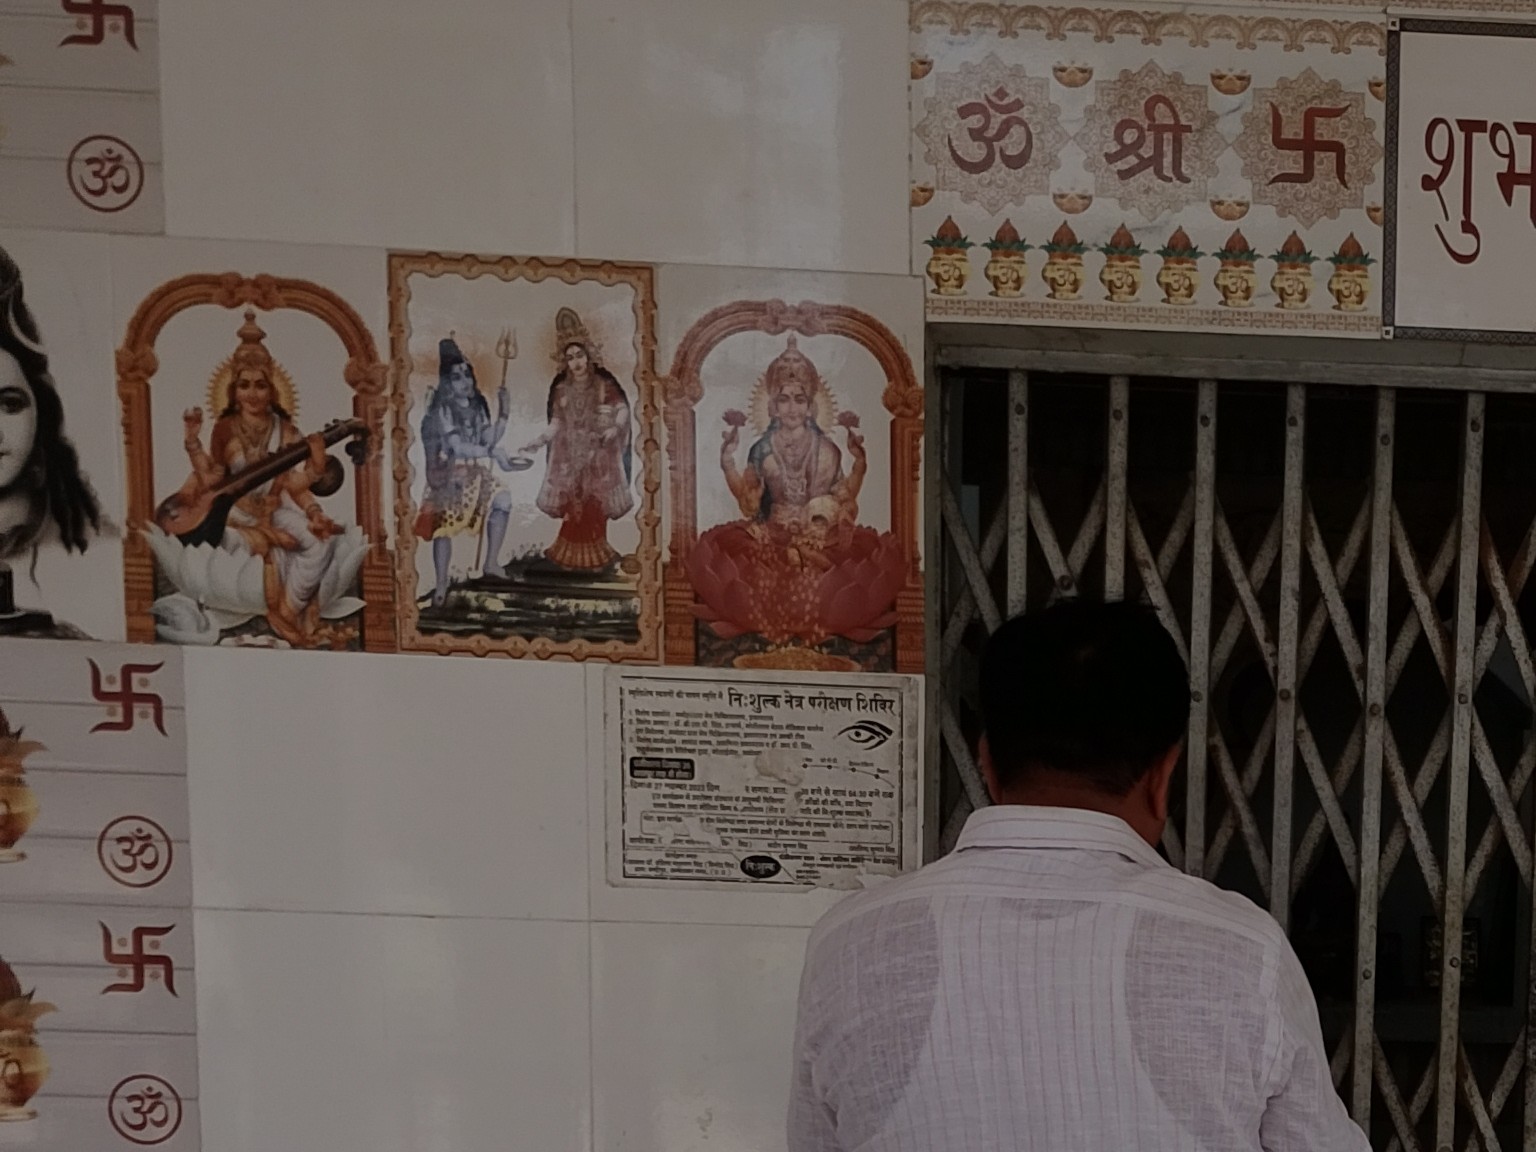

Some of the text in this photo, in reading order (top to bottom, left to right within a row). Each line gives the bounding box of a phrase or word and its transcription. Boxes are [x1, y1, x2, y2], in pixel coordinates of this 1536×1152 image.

[1104, 94, 1192, 184] श्री
[784, 689, 805, 710] नेत्र
[808, 691, 852, 712] परीक्षण
[856, 692, 896, 716] शिविर
